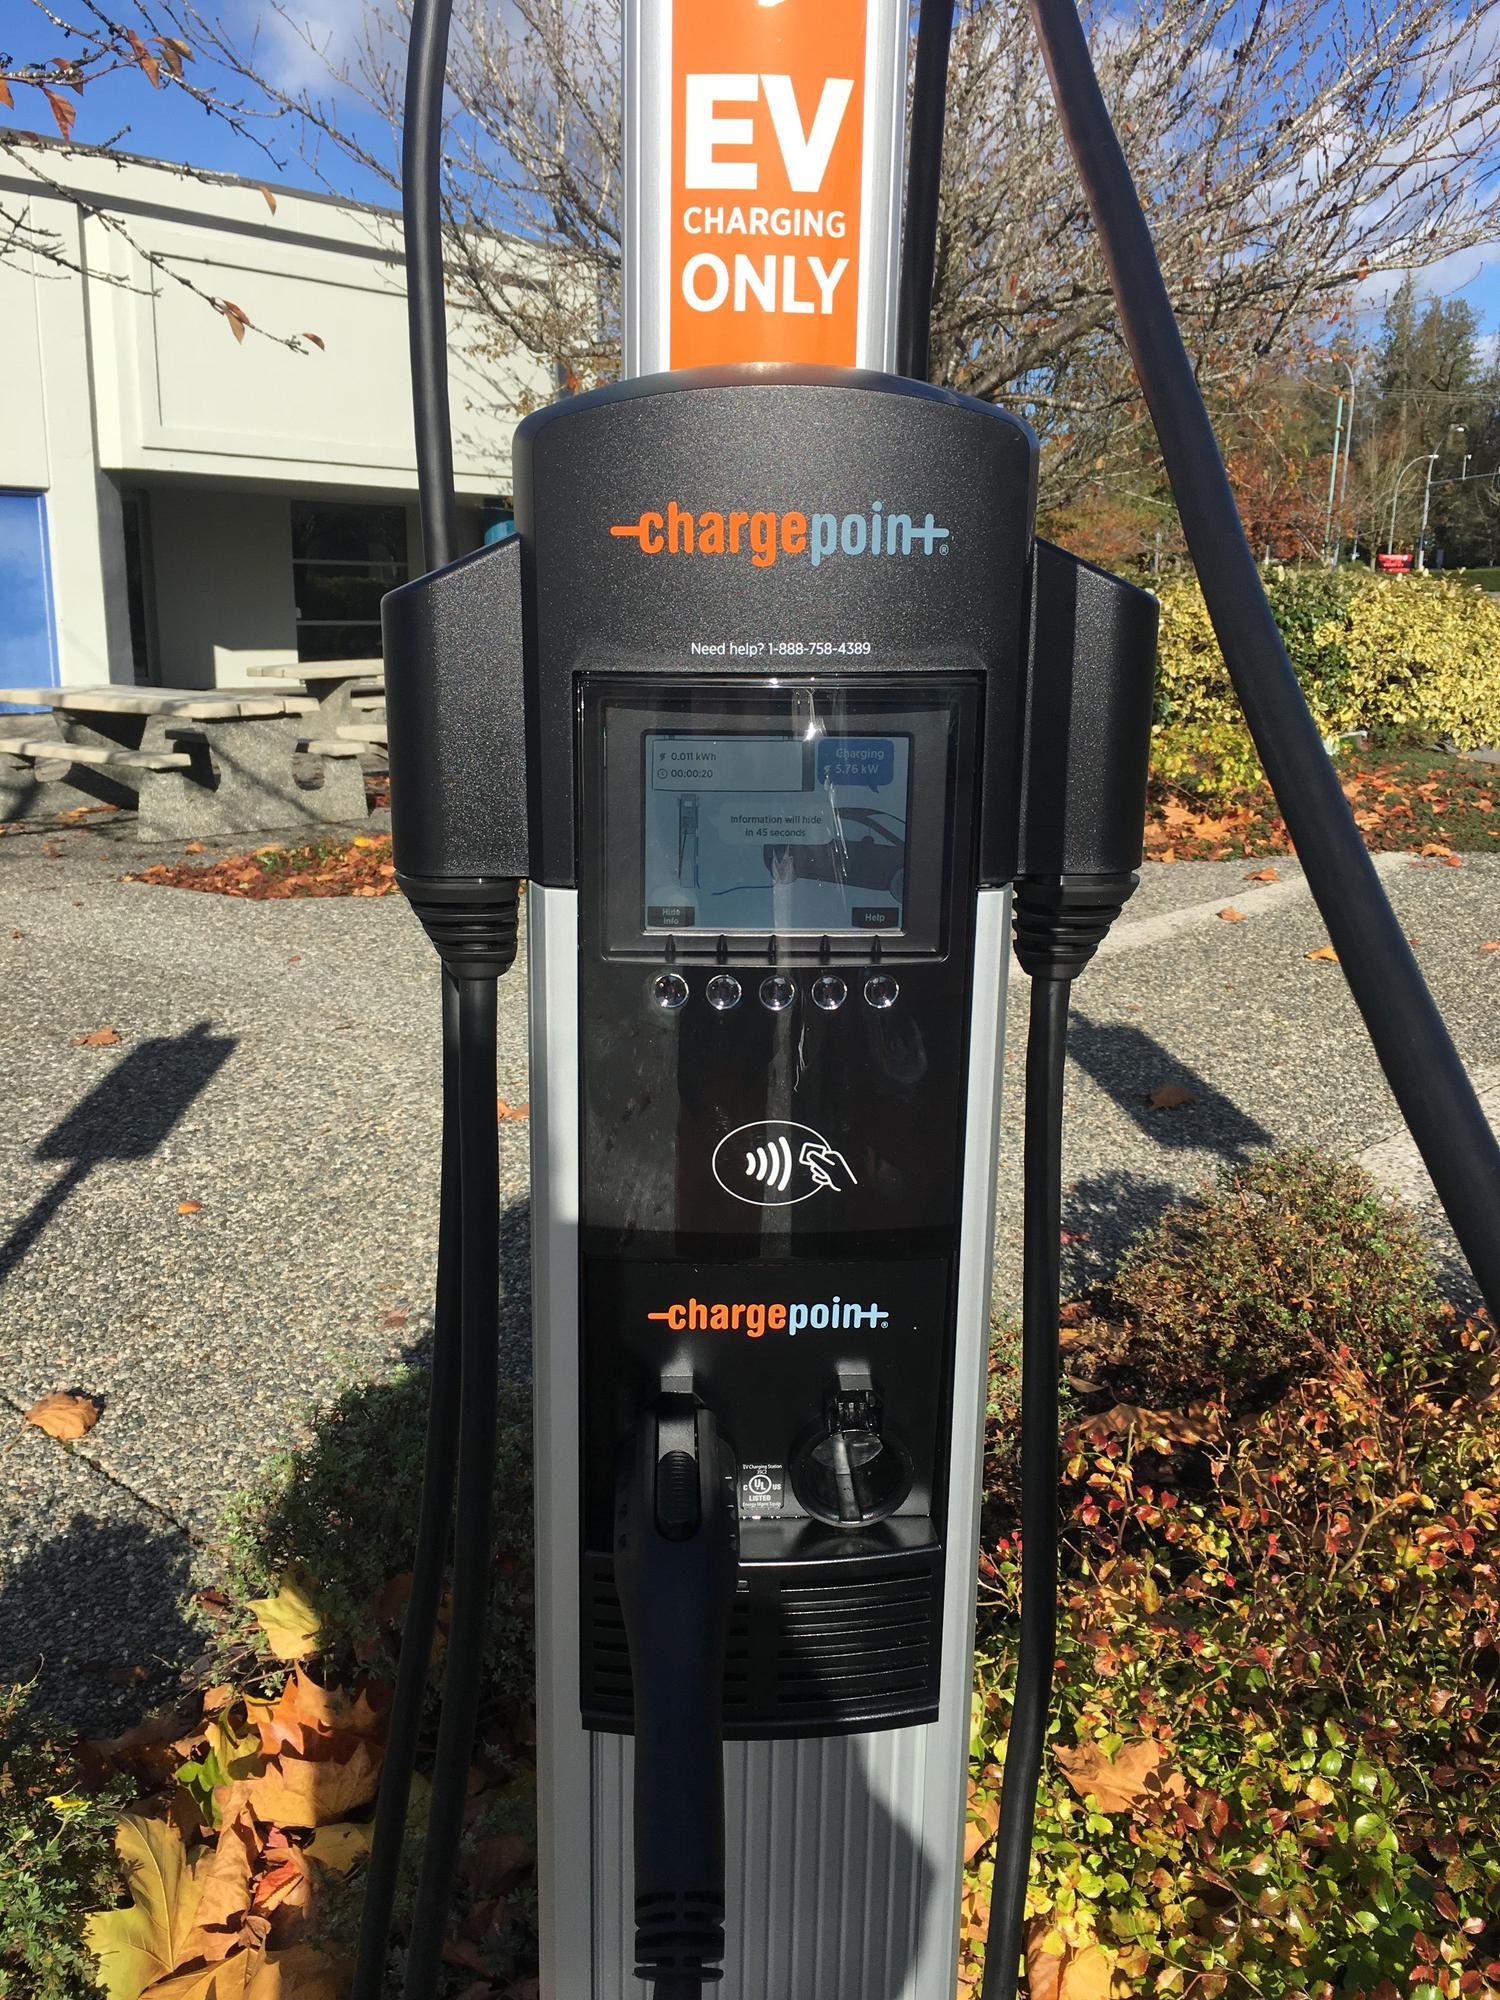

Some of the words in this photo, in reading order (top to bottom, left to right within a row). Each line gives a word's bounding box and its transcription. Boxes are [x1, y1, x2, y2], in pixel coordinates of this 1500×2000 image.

[685, 73, 855, 192] EV
[683, 206, 846, 238] CHARGING
[682, 252, 850, 315] ONLY
[690, 642, 727, 656] Need
[729, 642, 765, 658] help?
[768, 642, 872, 656] 1-888-758-4389
[671, 752, 694, 761] 0.011
[695, 752, 717, 761] kWh
[836, 748, 885, 760] Charging
[670, 769, 713, 778] 00:00:20
[835, 764, 859, 774] 5.76
[861, 764, 879, 774] kW
[730, 815, 783, 824] Information
[784, 816, 801, 824] will
[756, 827, 768, 837] 45
[769, 828, 806, 837] seconds
[864, 912, 886, 923] Help
